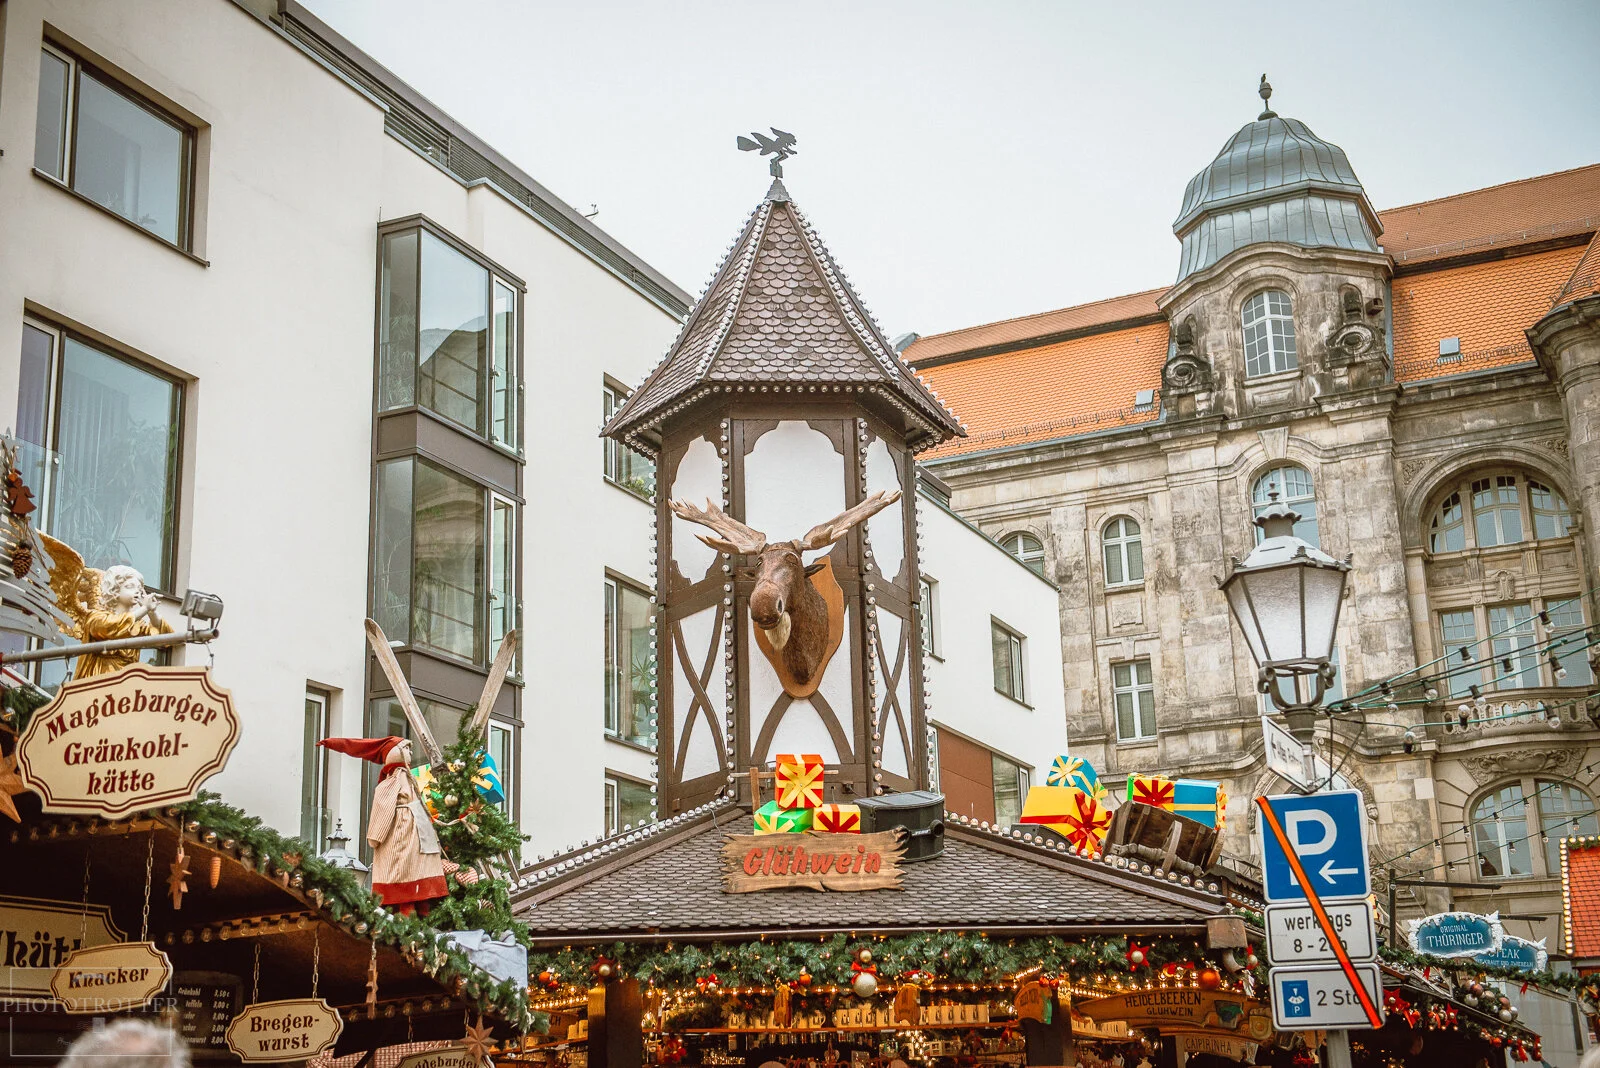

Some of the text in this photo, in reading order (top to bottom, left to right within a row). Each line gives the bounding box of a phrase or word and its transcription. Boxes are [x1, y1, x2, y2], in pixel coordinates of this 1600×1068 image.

[46, 689, 217, 745] Magdeburger
[63, 732, 189, 766] Grünkohl-
[87, 769, 155, 796] hütte
[1284, 809, 1338, 886] P
[743, 845, 881, 876] Glühwein
[1284, 913, 1352, 932] werkgs
[1440, 924, 1468, 934] ORIGINAL
[1294, 939, 1303, 953] 8
[1426, 932, 1485, 948] THÜRINGER
[68, 967, 149, 989] Knacker
[1316, 990, 1328, 1006] 2
[250, 1015, 320, 1034] Bregen-
[258, 1033, 310, 1052] wurst
[1185, 1037, 1233, 1055] CAIPIRINHA
